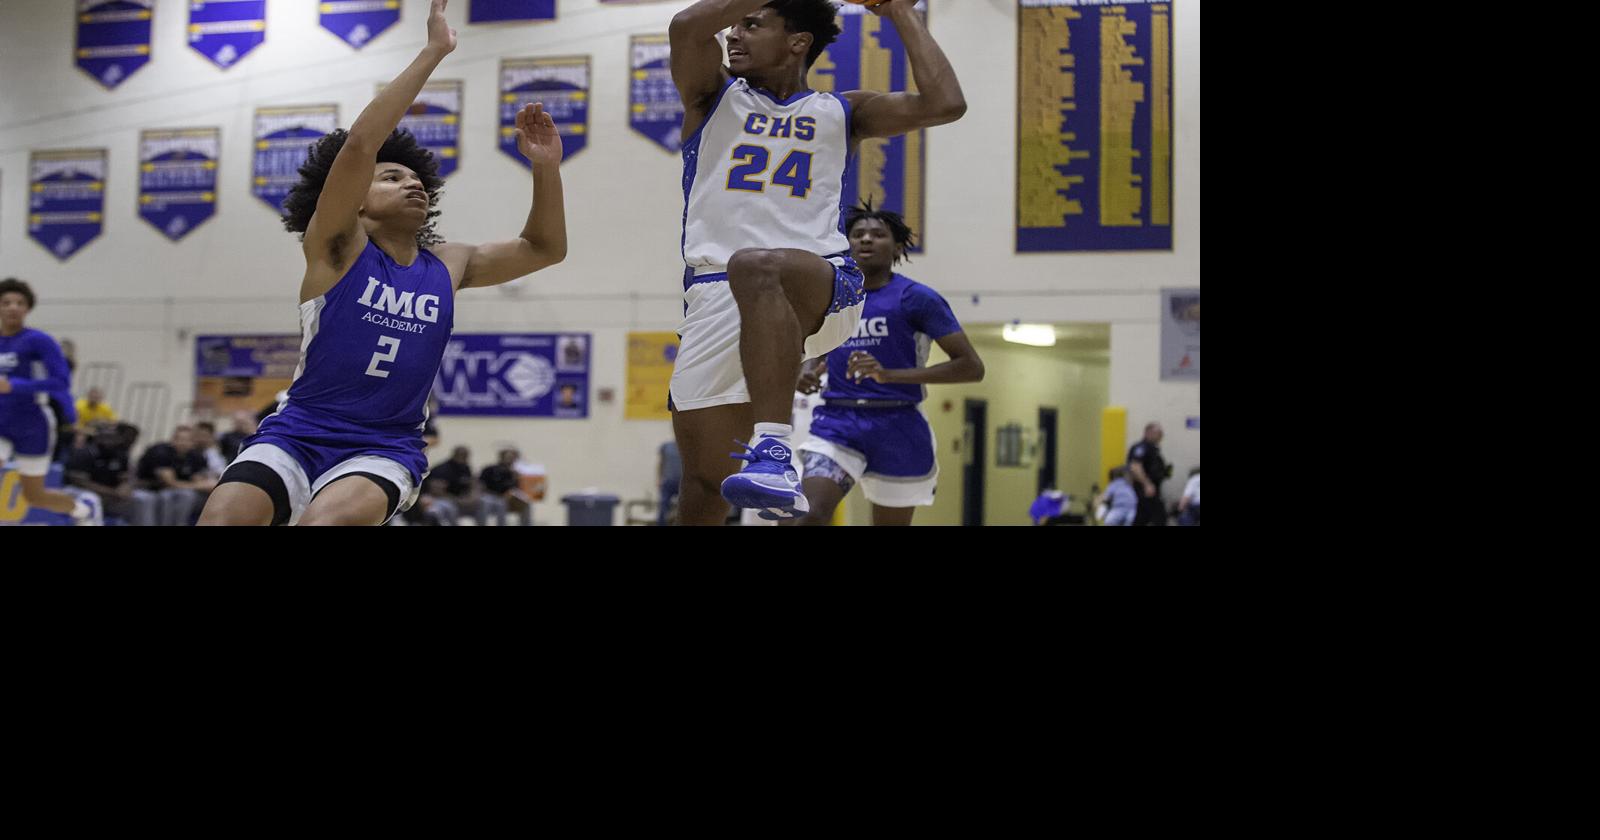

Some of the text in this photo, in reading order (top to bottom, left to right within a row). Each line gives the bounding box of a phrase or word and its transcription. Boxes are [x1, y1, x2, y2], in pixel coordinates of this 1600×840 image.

[744, 112, 816, 141] CHS
[725, 143, 814, 199] 24
[357, 276, 439, 323] IMG
[361, 311, 427, 333] ACADEMY
[365, 335, 401, 378] 2
